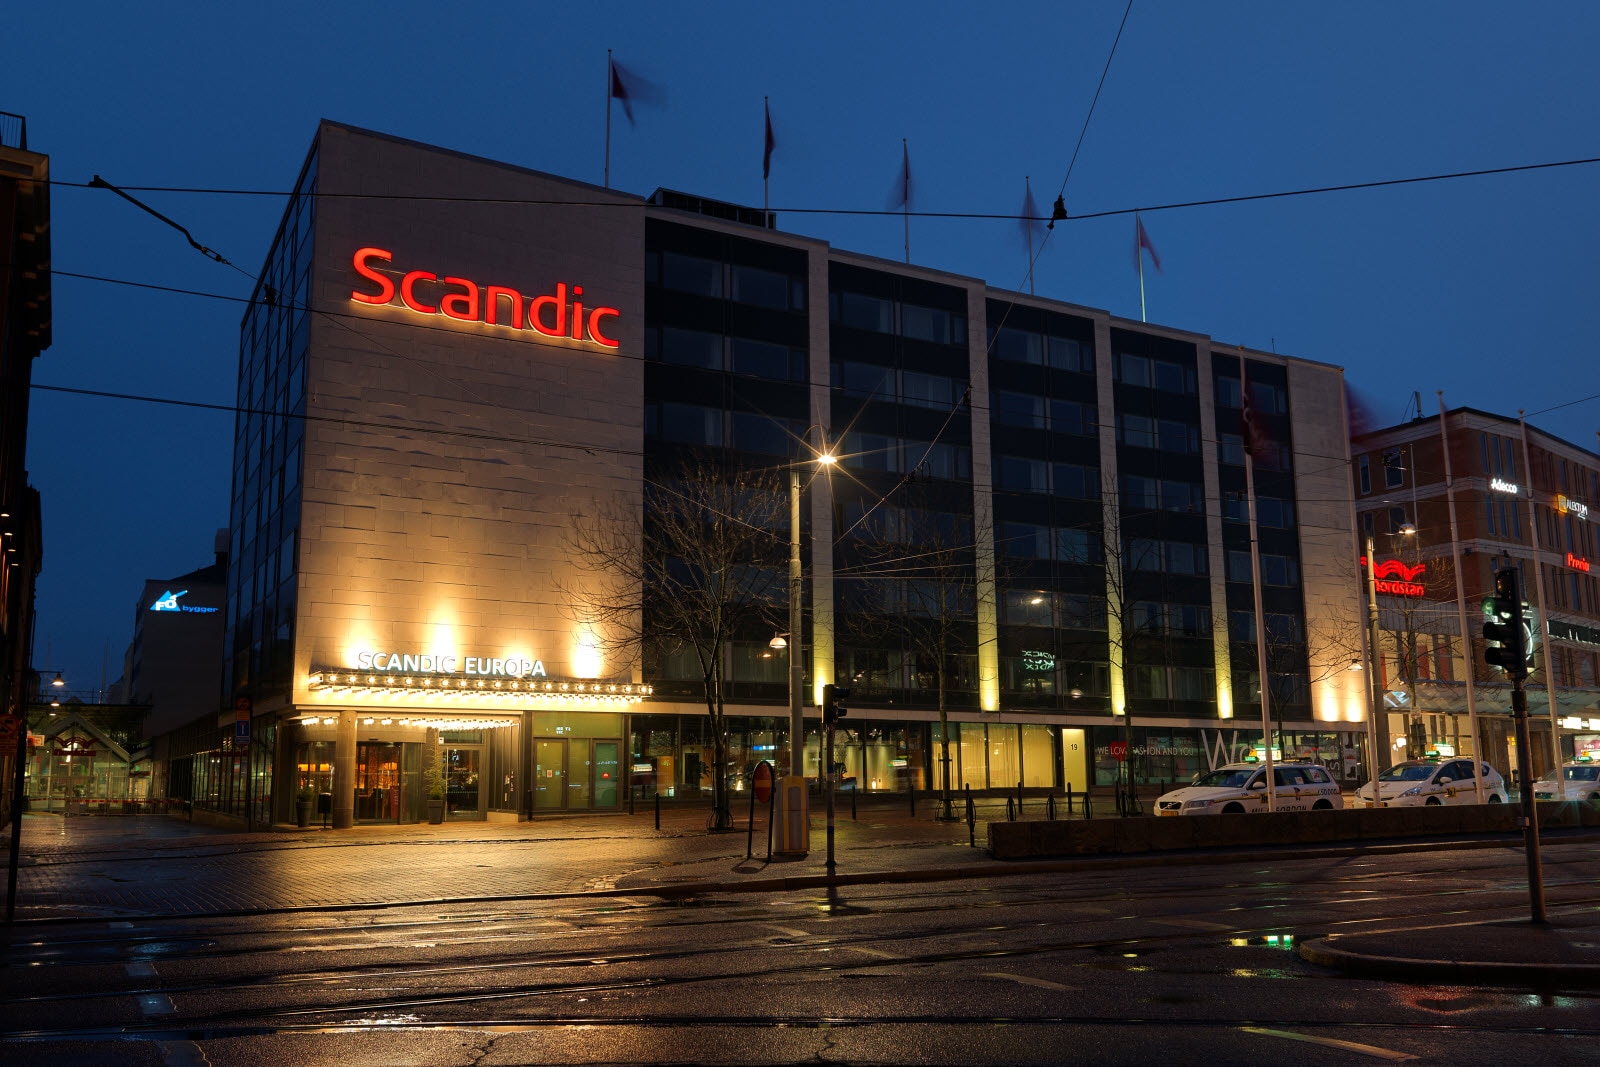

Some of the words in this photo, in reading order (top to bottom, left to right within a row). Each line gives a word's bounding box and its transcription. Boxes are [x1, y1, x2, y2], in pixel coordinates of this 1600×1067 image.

[351, 247, 620, 348] Scandic
[1491, 478, 1517, 494] Adecco
[182, 605, 219, 613] bygger
[357, 651, 456, 674] SCANDIC
[464, 656, 546, 677] EUROPA
[1070, 743, 1078, 751] 19
[1097, 746, 1109, 755] WE
[1110, 746, 1128, 755] LOV
[1162, 747, 1178, 756] AND
[1179, 747, 1194, 756] YOU
